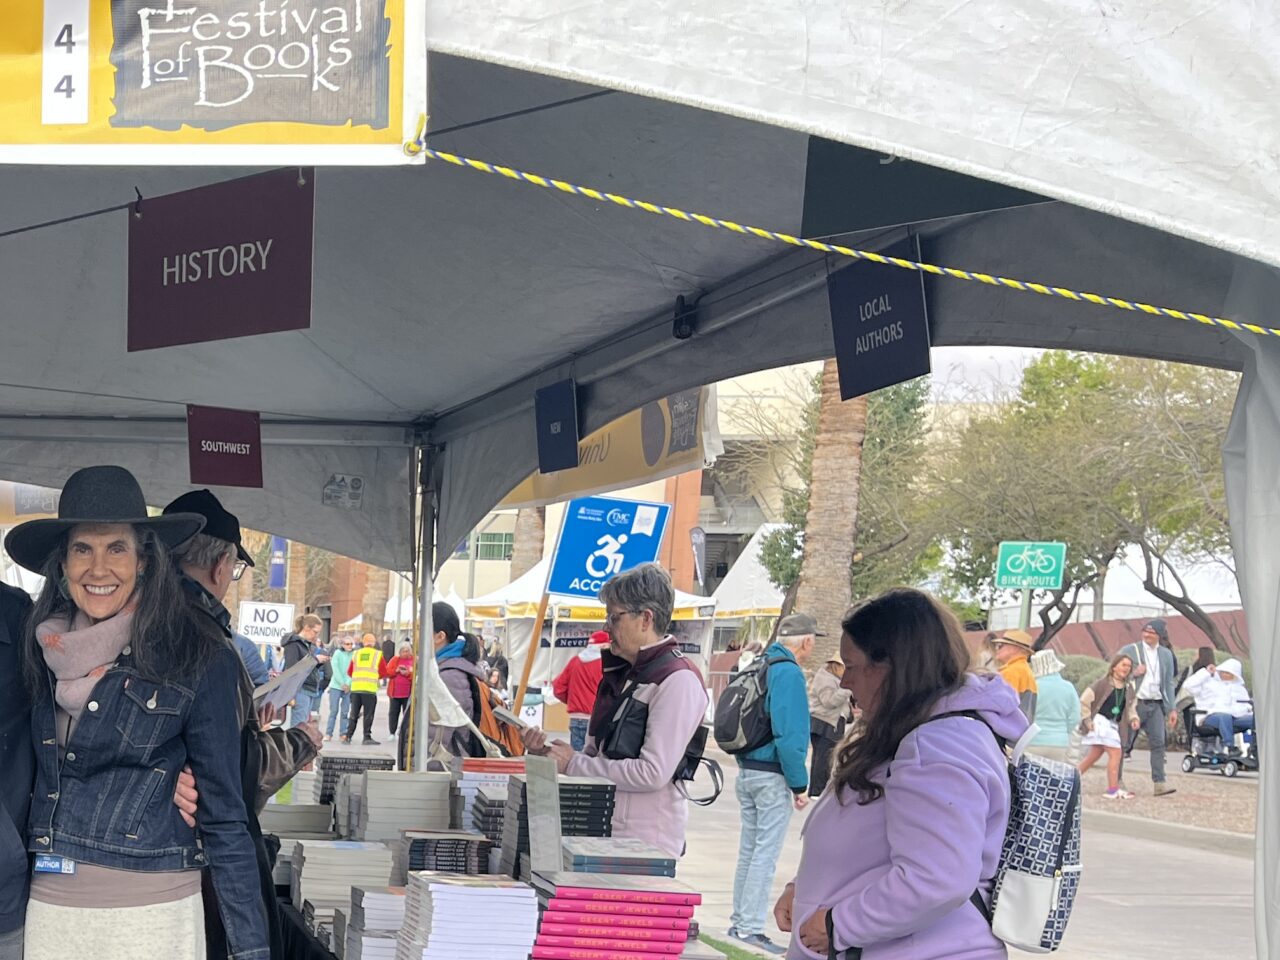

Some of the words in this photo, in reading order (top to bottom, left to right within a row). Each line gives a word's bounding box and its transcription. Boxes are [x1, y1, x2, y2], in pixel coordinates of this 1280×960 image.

[138, 0, 363, 89] Festival
[154, 41, 192, 75] of
[195, 34, 353, 107] Books
[162, 238, 273, 286] HISTORY
[858, 294, 892, 323] LOCAL
[855, 320, 904, 356] AUTHORS
[550, 421, 562, 434] NEW
[201, 439, 251, 455] SOUTHWEST
[1001, 575, 1023, 585] BIKE
[1026, 576, 1056, 586] ROUTE
[253, 608, 279, 624] NO
[243, 625, 286, 637] STANDING
[560, 639, 587, 647] Never
[592, 892, 627, 902] DESERT
[632, 894, 666, 903] JEWELS
[585, 904, 620, 912] DESERT
[624, 906, 659, 914] JEWELS
[580, 916, 614, 925] DESERT
[618, 918, 654, 927] JEWELS
[578, 927, 612, 936] DESERT
[615, 930, 652, 938] JEWELS
[574, 938, 608, 947] DESERT
[612, 940, 648, 950] JEWELS
[570, 951, 605, 959] DESERT
